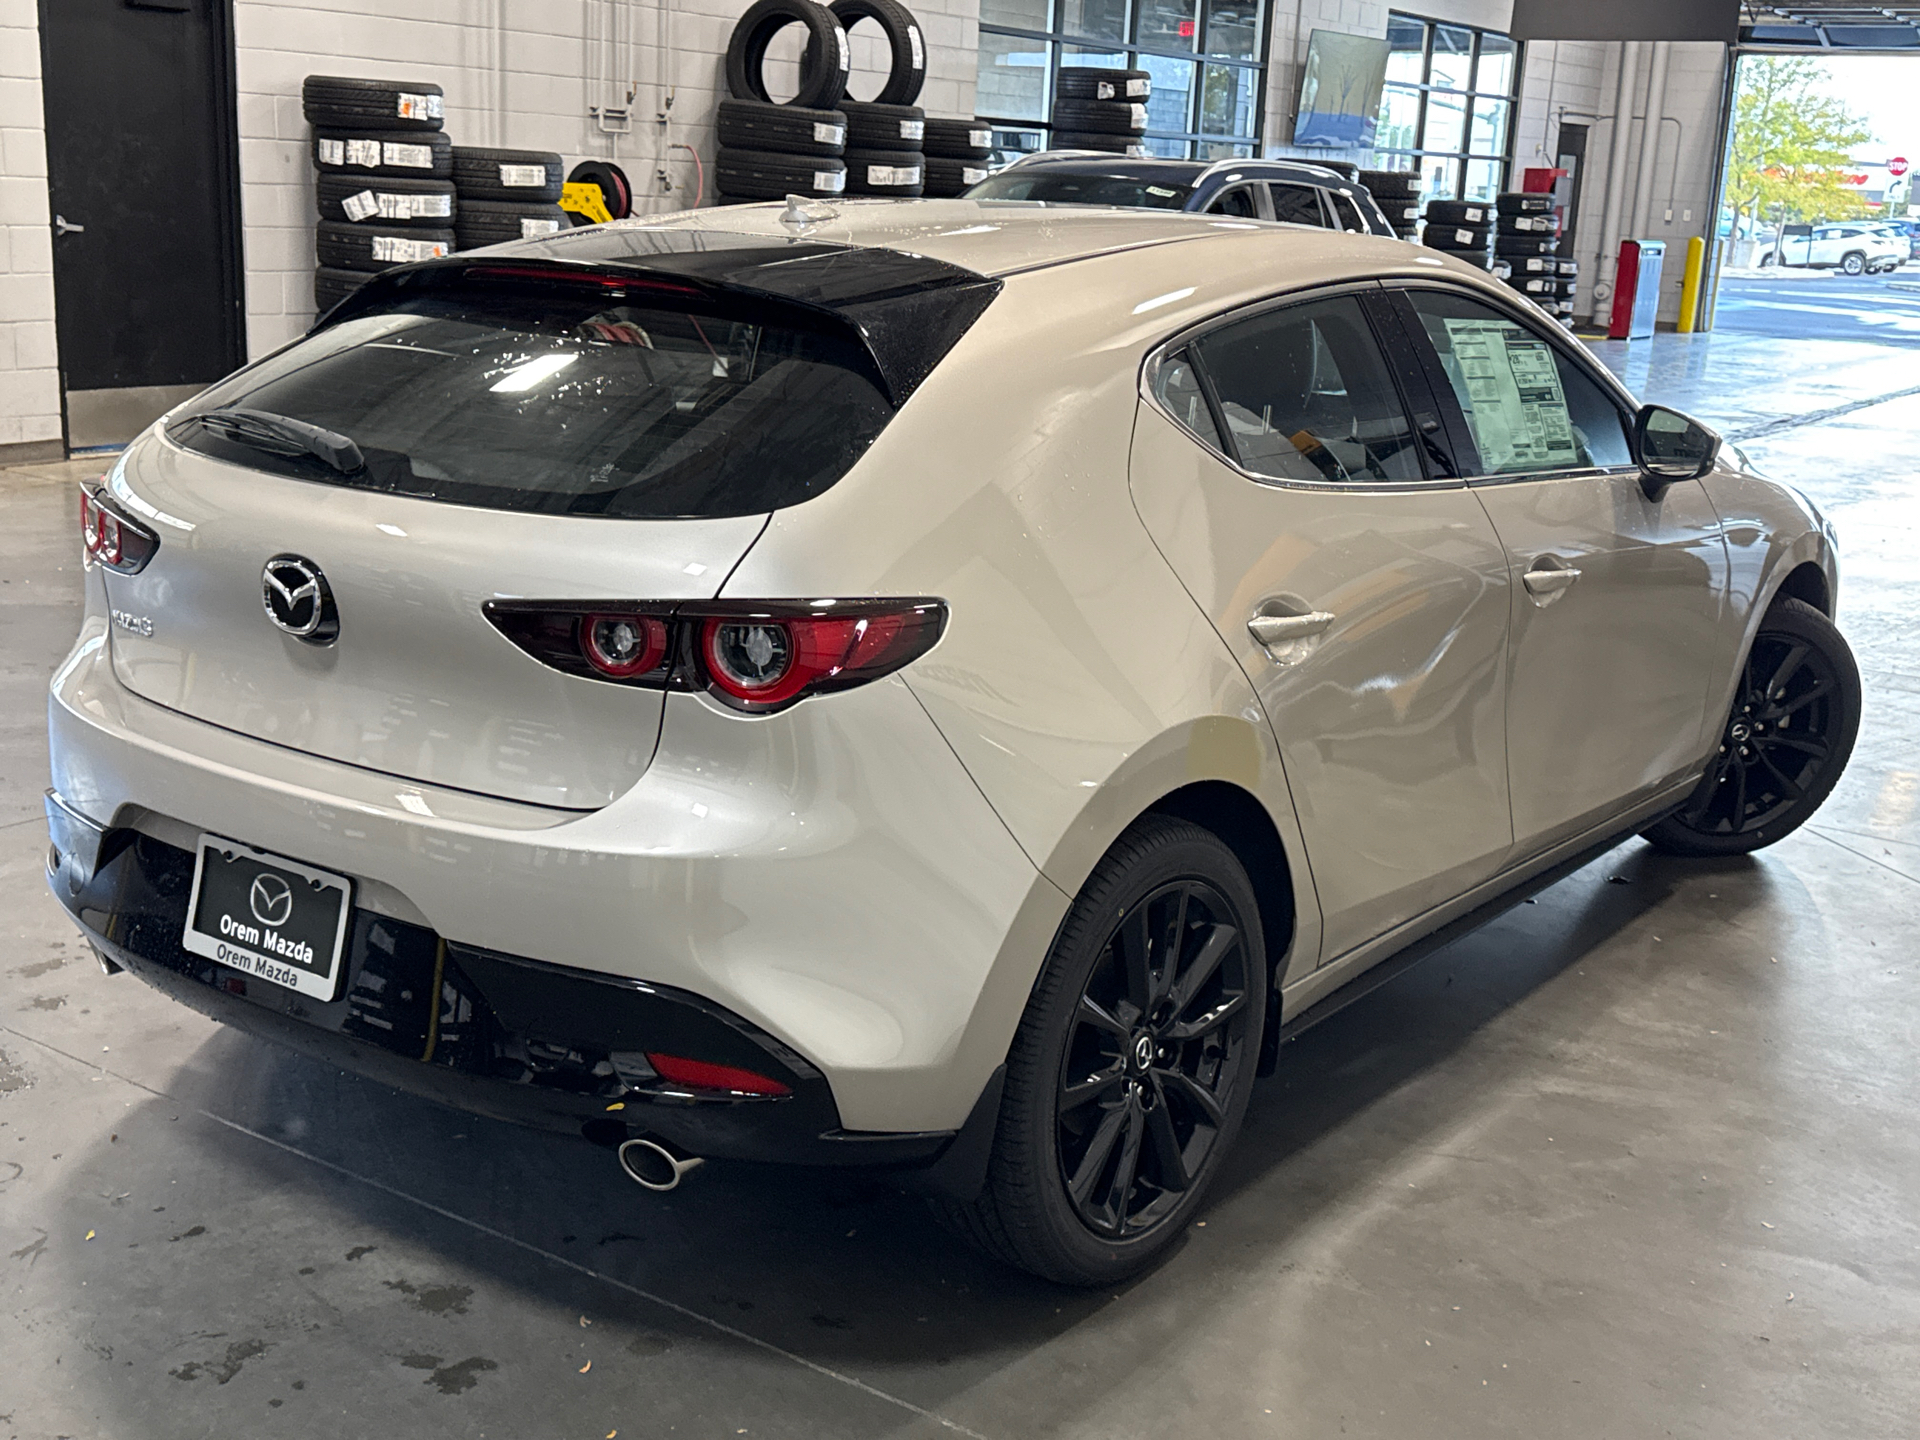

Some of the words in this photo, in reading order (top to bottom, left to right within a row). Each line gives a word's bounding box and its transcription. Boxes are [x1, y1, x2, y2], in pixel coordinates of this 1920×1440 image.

[1889, 161, 1908, 172] STOP
[220, 914, 260, 945] Orem
[263, 928, 313, 964] Mazda
[216, 943, 252, 970] Orem
[254, 957, 298, 987] Mazda
